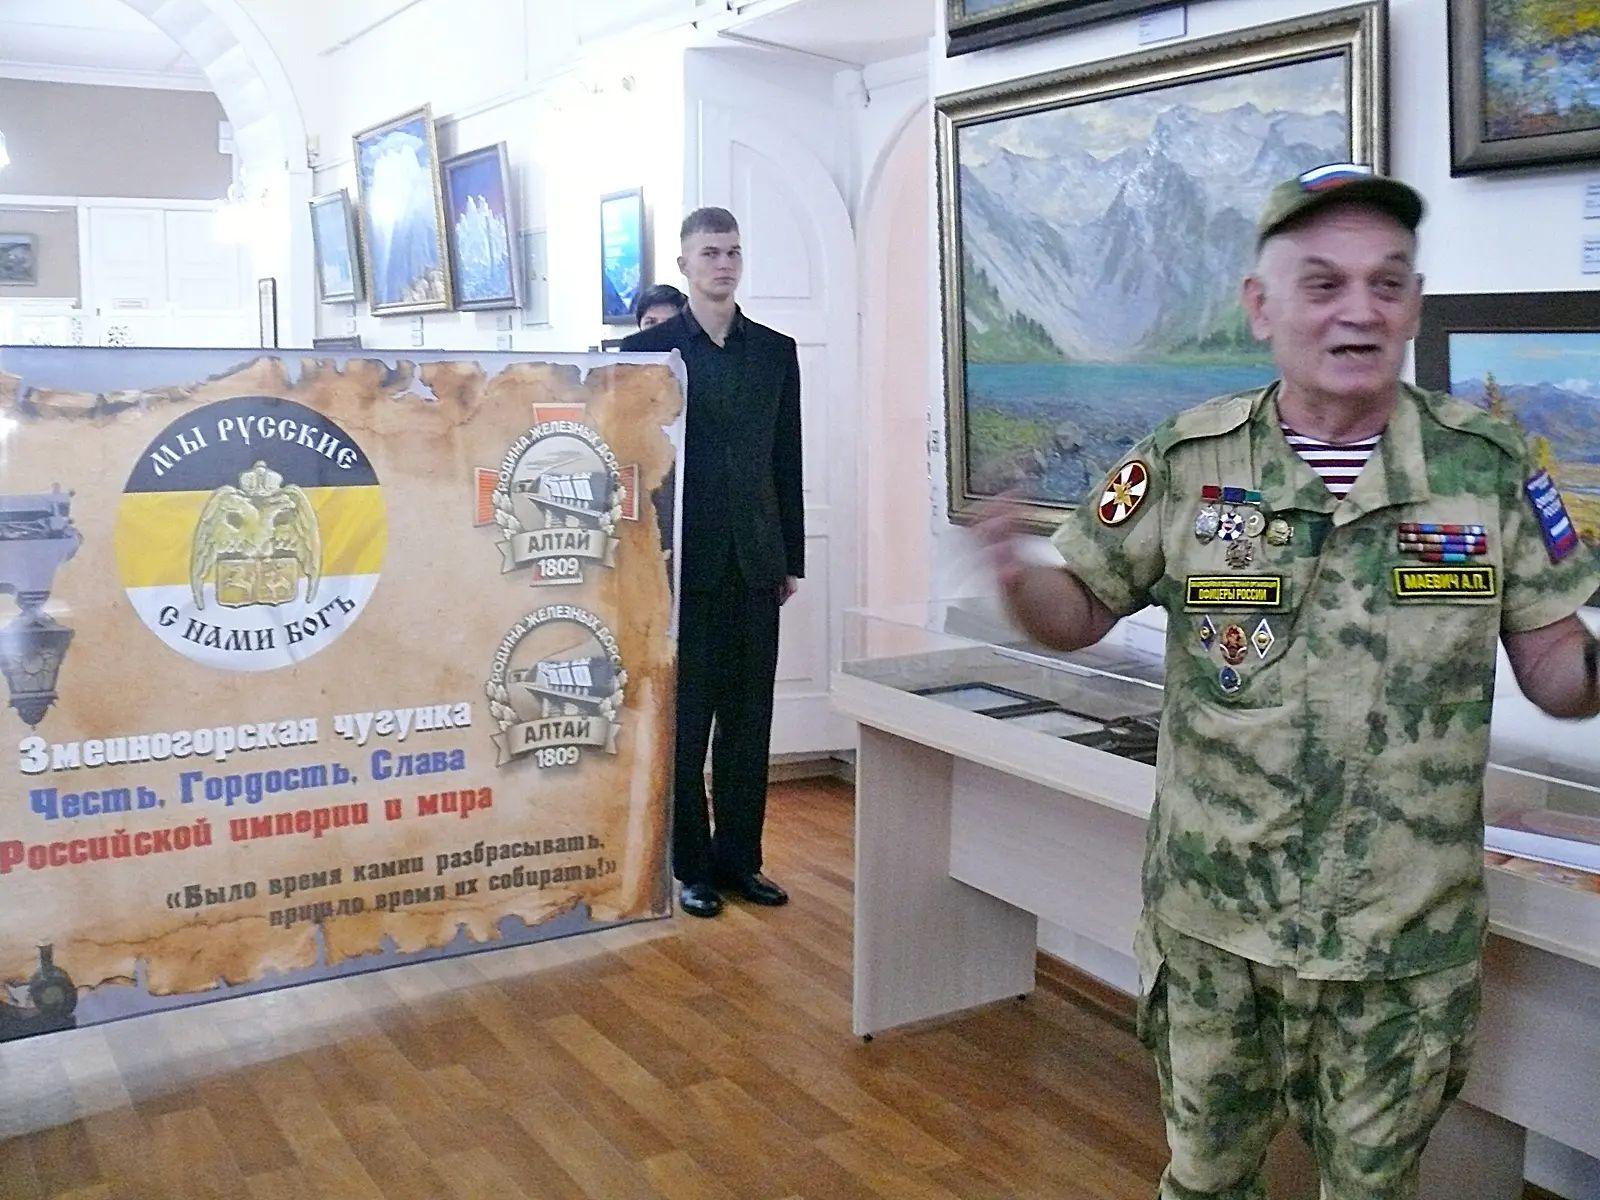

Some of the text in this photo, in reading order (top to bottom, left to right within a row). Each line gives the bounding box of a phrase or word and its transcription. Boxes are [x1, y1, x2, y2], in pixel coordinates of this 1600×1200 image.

[150, 415, 358, 477] МЫ РУССКИЕ
[496, 420, 621, 493] РОДИНА ЖЕЛЕЗНЫХ ДОРО
[528, 528, 590, 553] АЛТАЙ
[537, 558, 579, 577] 1809
[1198, 588, 1267, 601] ОФИЦЕРЫ РОССИИ
[1403, 573, 1460, 589] МАЕВИЧ
[159, 596, 356, 651] С НАМИ БОГЪ
[491, 605, 623, 683] РОДИНА ЖЕЛЕЗНЫХ ДОРО
[19, 702, 472, 775] Змеиногорская чугунка
[525, 716, 590, 744] АЛТАЙ
[535, 747, 580, 768] 1809
[30, 749, 466, 821] Честь, Гордость, Слава
[0, 786, 493, 874] Российской империи и мира
[166, 881, 257, 909] «Было
[269, 868, 342, 898] время
[353, 856, 424, 882] камни
[269, 858, 617, 929] пришло время их собирать!»
